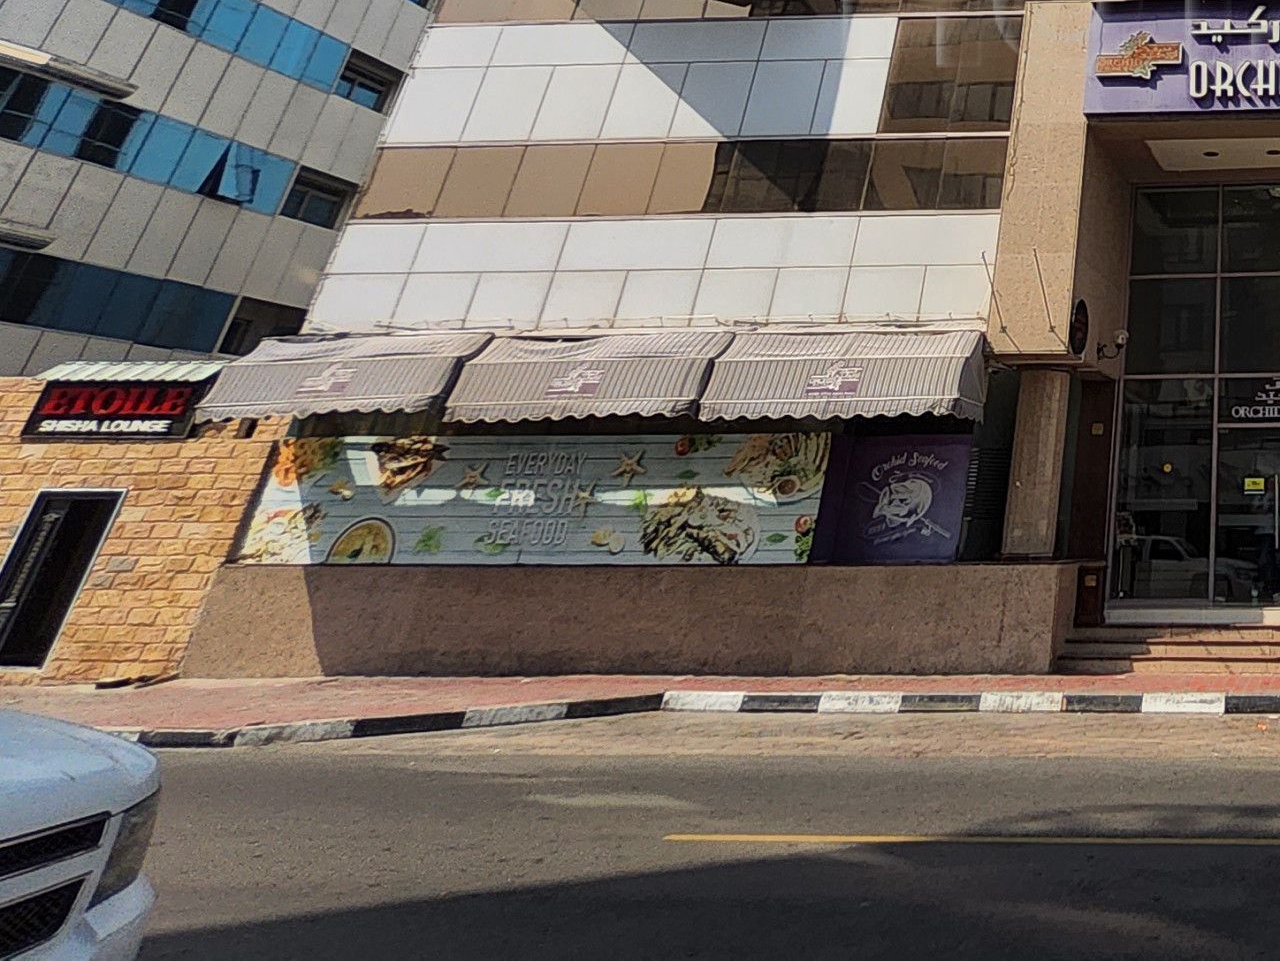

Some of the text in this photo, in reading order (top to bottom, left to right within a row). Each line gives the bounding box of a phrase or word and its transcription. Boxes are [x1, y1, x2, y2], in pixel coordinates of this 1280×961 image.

[38, 387, 193, 416] ETOILE
[38, 419, 173, 433] SHISHA LOUNGE
[491, 477, 581, 516] FRESH
